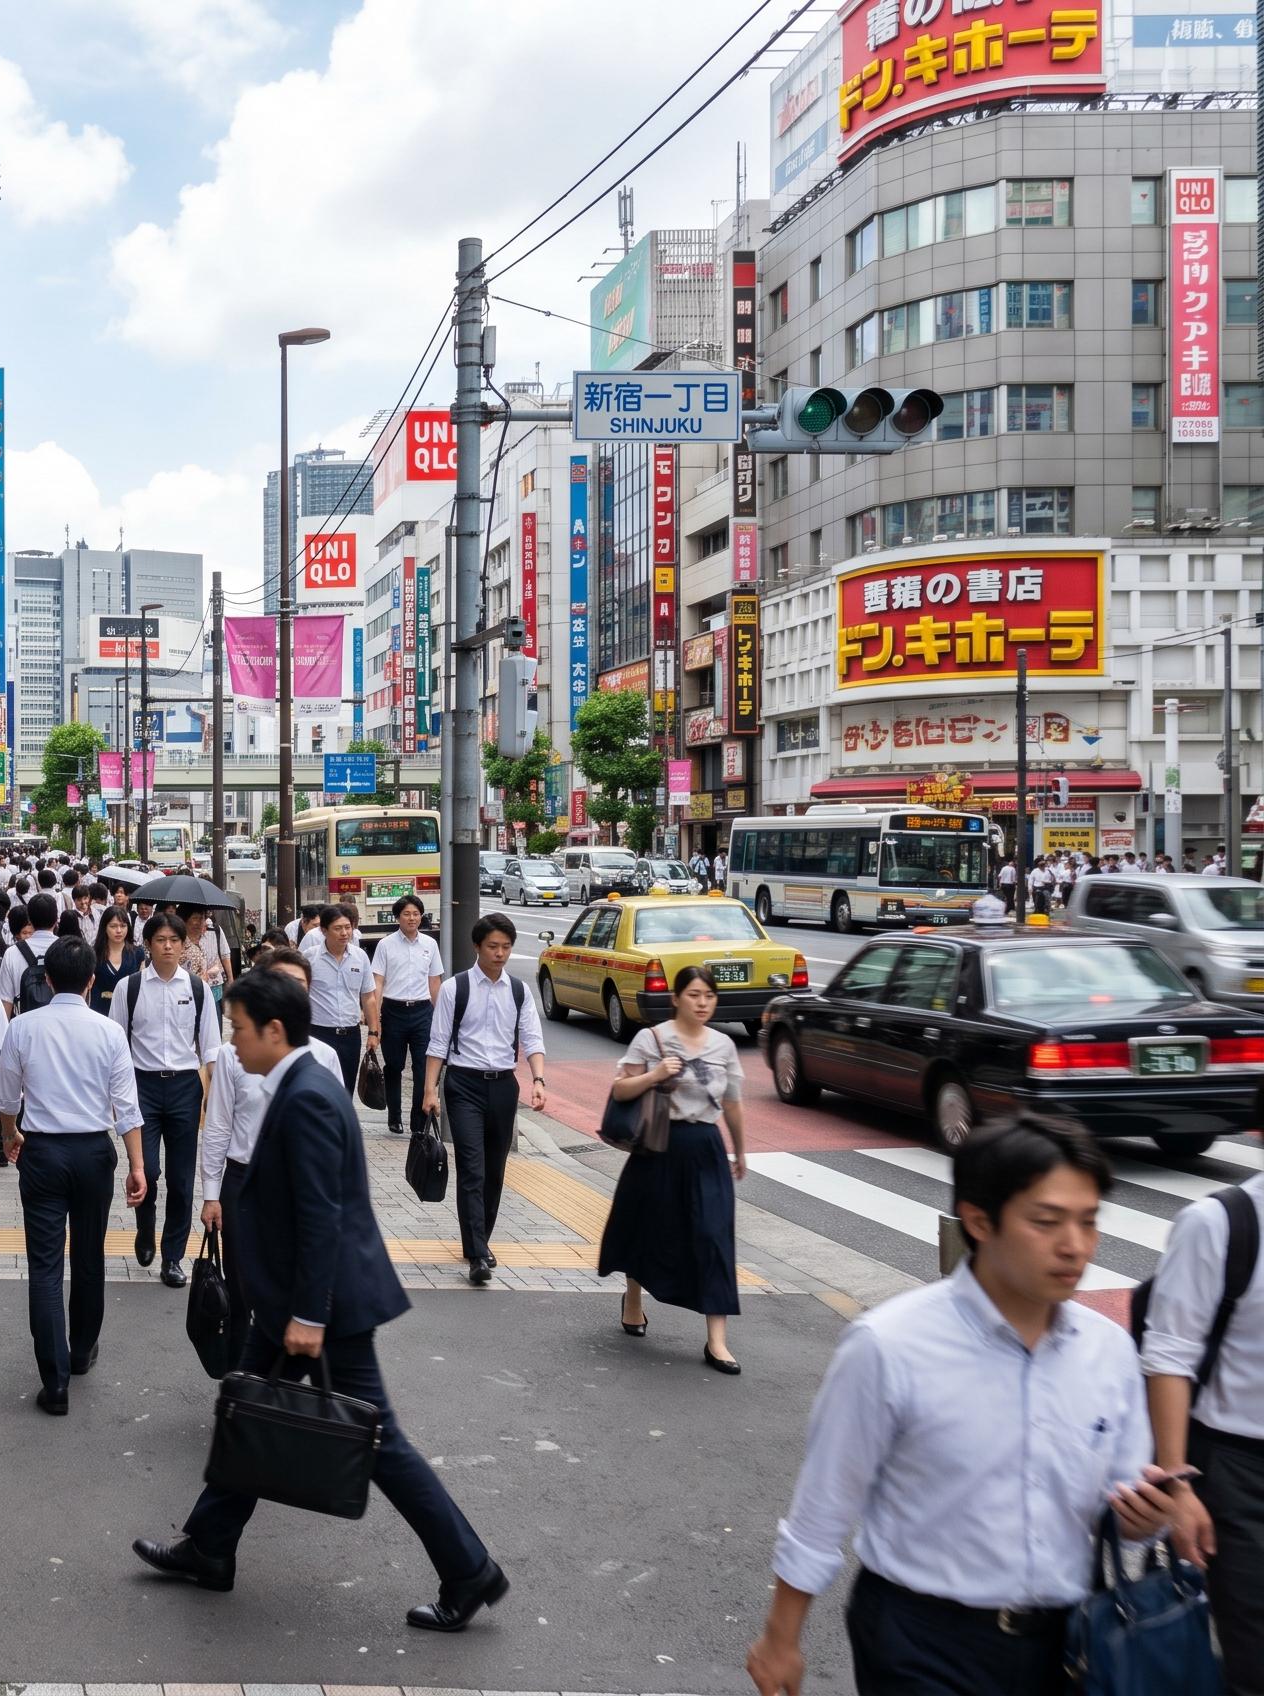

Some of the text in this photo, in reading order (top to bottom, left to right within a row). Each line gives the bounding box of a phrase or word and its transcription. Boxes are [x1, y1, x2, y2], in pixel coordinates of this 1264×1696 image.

[1180, 181, 1208, 195] UNI
[1179, 197, 1211, 213] QLO
[584, 382, 729, 413] 新宿一丁目
[610, 417, 702, 434] SHINJUKU
[310, 540, 348, 560] UNI
[310, 562, 351, 585] QLO
